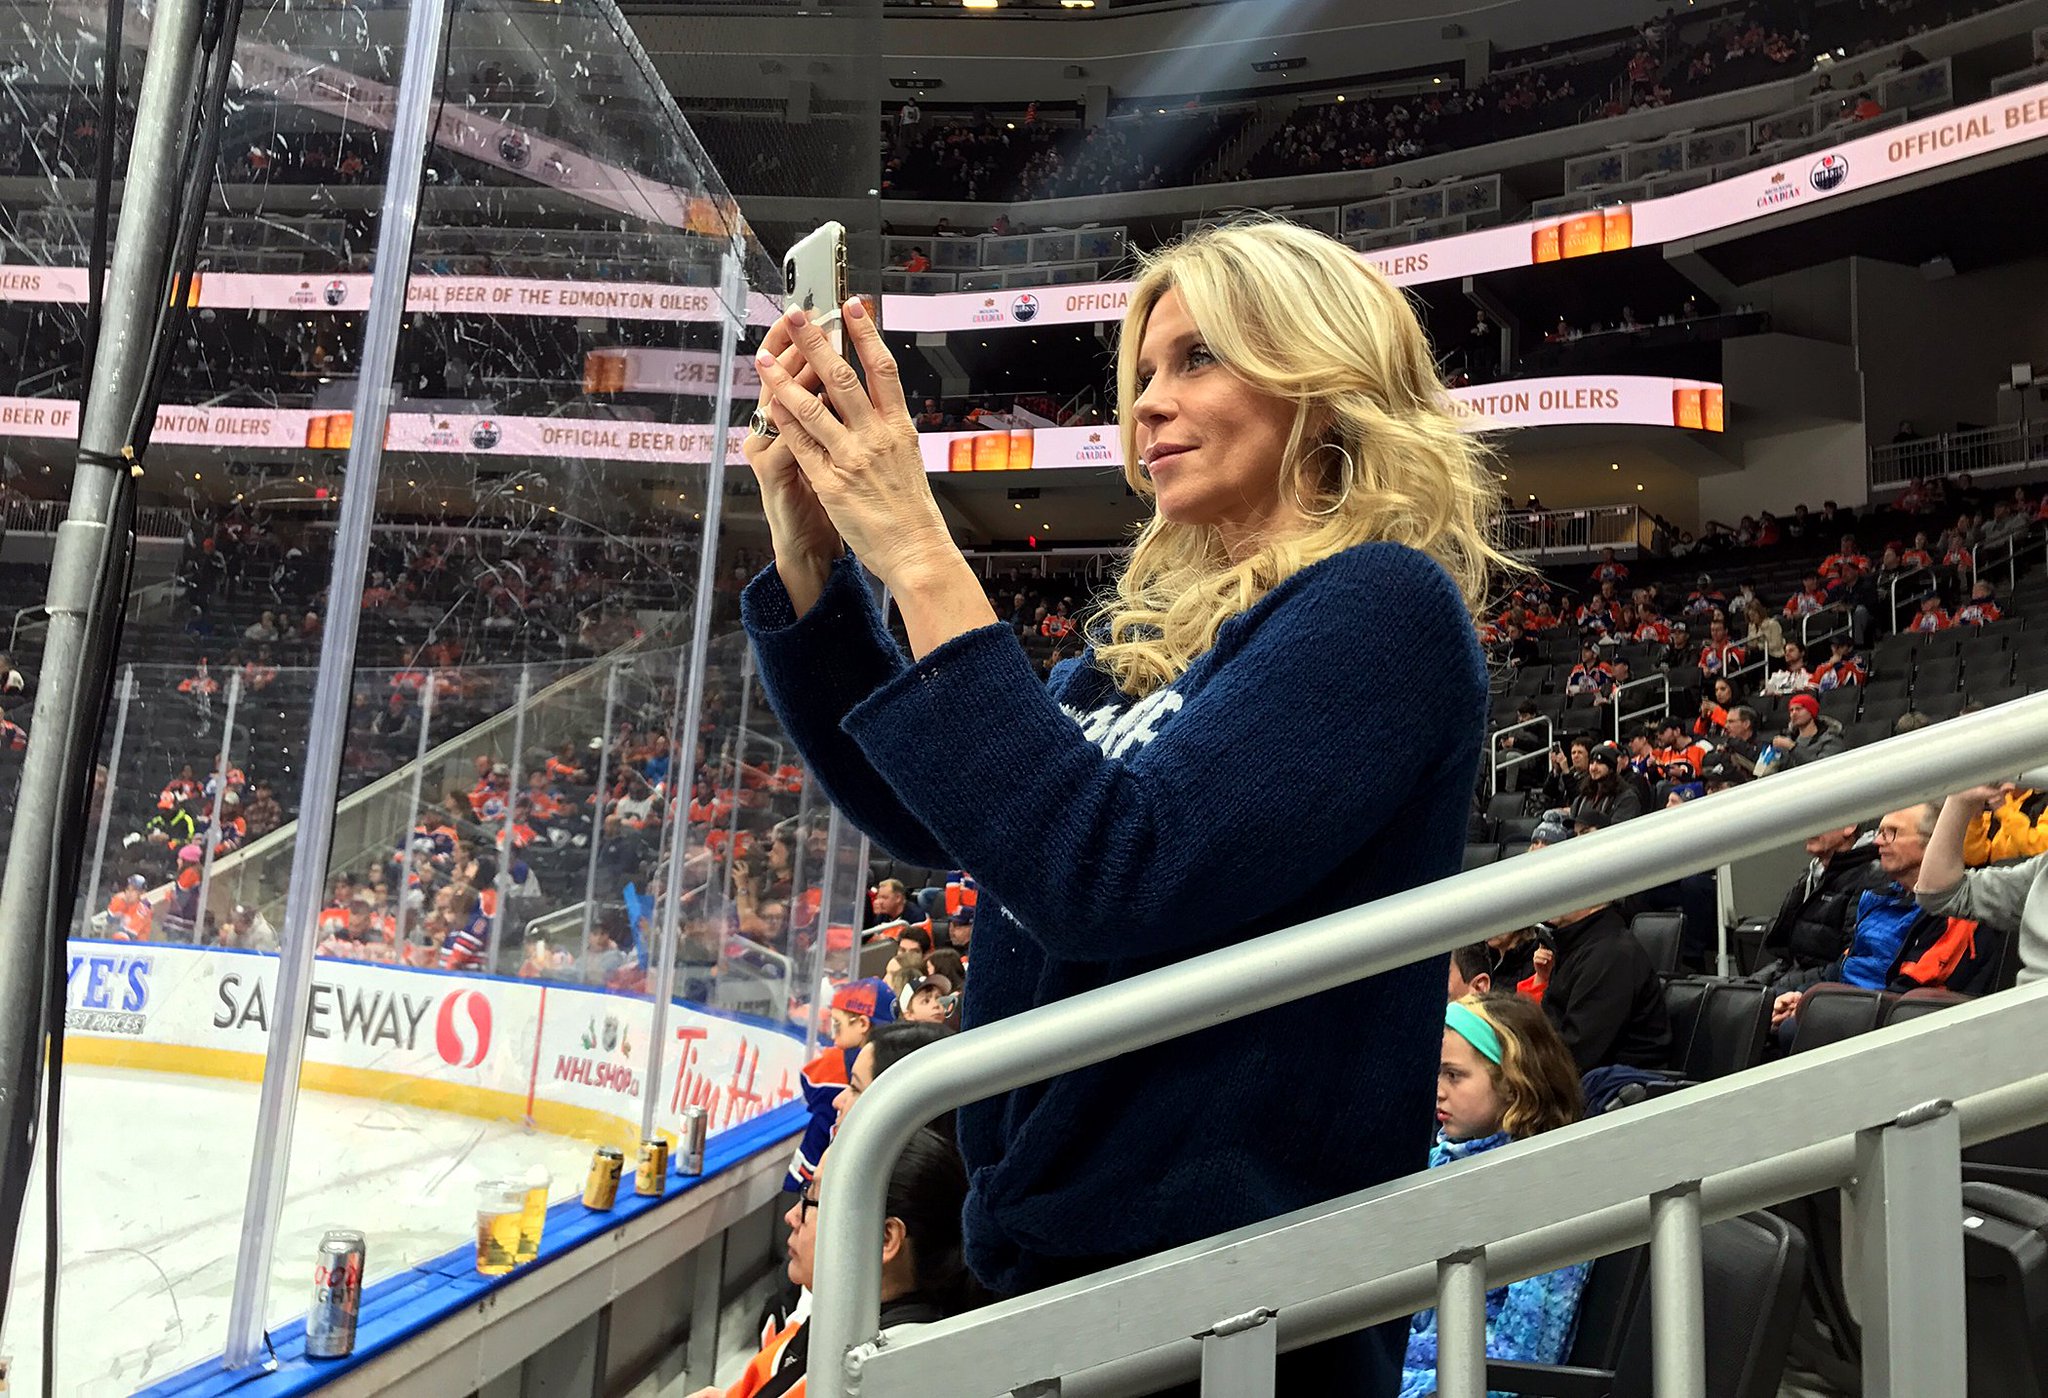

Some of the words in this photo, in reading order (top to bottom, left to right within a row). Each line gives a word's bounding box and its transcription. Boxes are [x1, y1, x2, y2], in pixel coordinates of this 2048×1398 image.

[1888, 115, 1995, 162] OFFICIAL
[1757, 187, 1800, 207] CANADIAN
[445, 286, 486, 302] BEER
[492, 288, 513, 303] OF
[519, 288, 552, 305] THE
[559, 290, 653, 309] EDMONTON
[660, 294, 708, 311] OILERS
[1449, 391, 1530, 418] ONTON
[1539, 388, 1620, 411] OILERS
[3, 406, 45, 425] BEER
[51, 409, 72, 427] OF
[215, 418, 271, 436] OILERS
[543, 427, 620, 448] OFFICIAL
[629, 431, 674, 450] BEER
[680, 435, 696, 451] OF
[1076, 451, 1112, 460] CANADIAN
[213, 973, 434, 1050] SAEWAY
[671, 1026, 721, 1130] Tim
